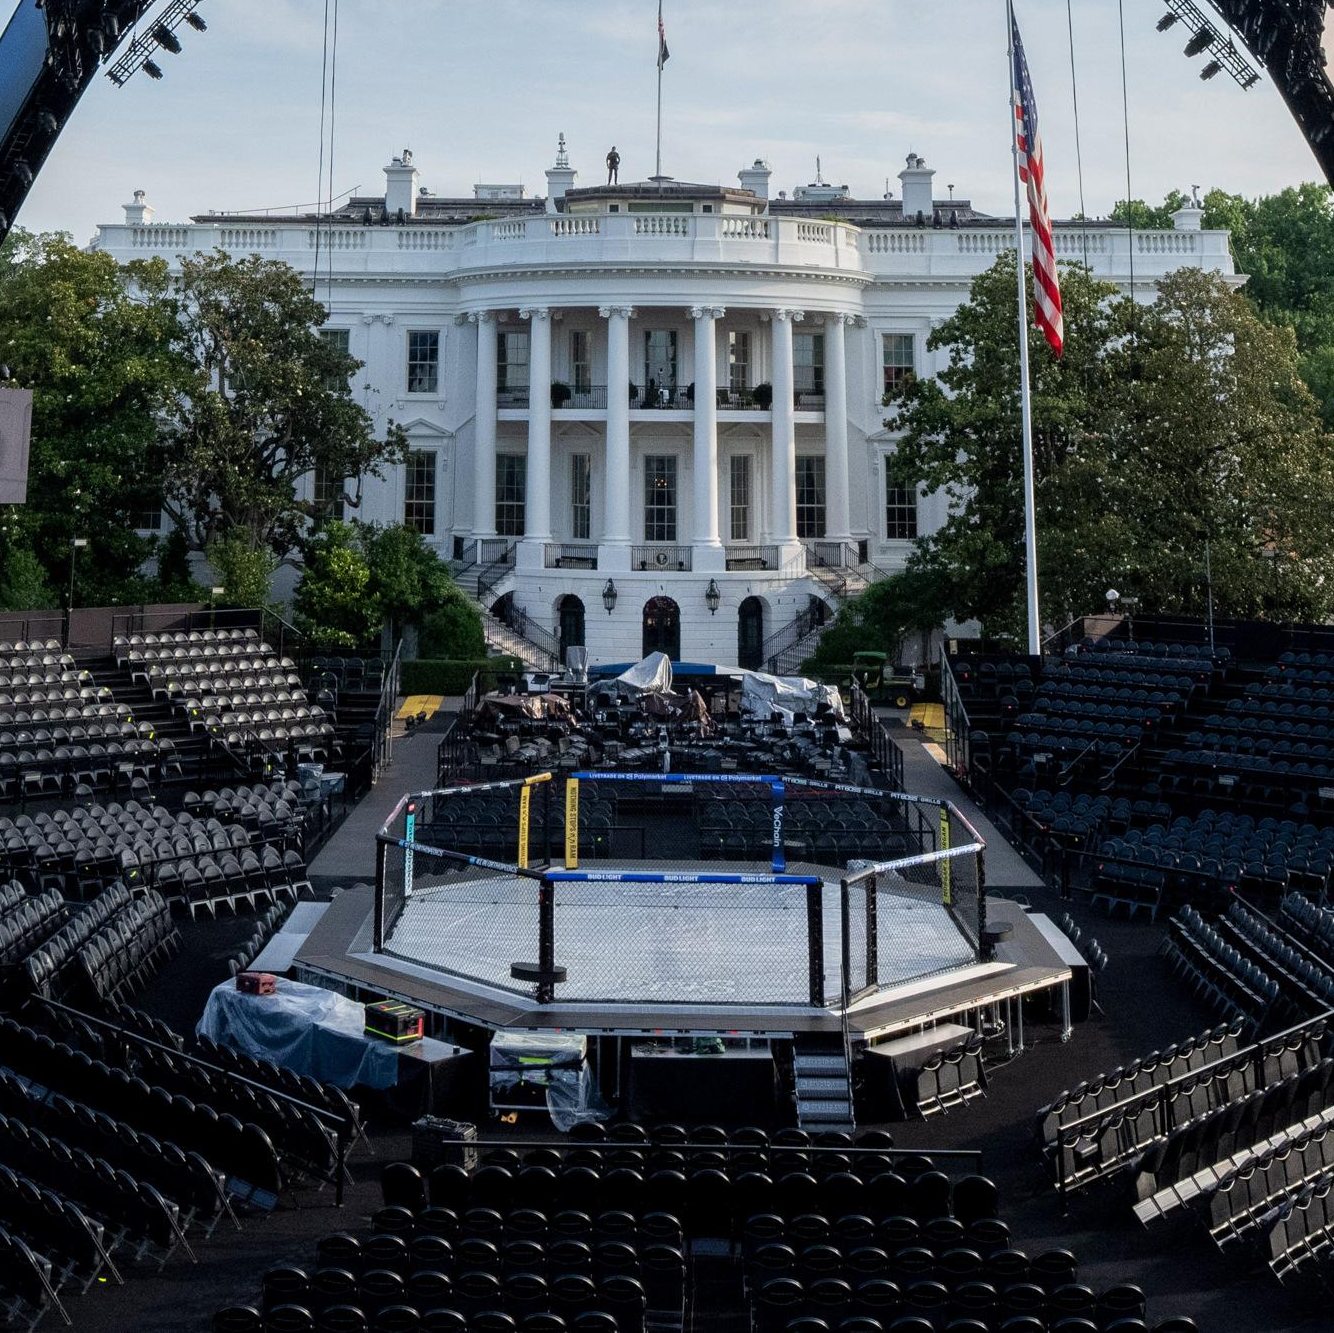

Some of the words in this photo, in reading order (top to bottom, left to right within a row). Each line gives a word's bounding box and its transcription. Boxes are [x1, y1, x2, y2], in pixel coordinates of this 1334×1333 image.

[634, 773, 667, 781] Polymarket
[569, 813, 577, 832] STOPS
[773, 804, 784, 847] VeChain
